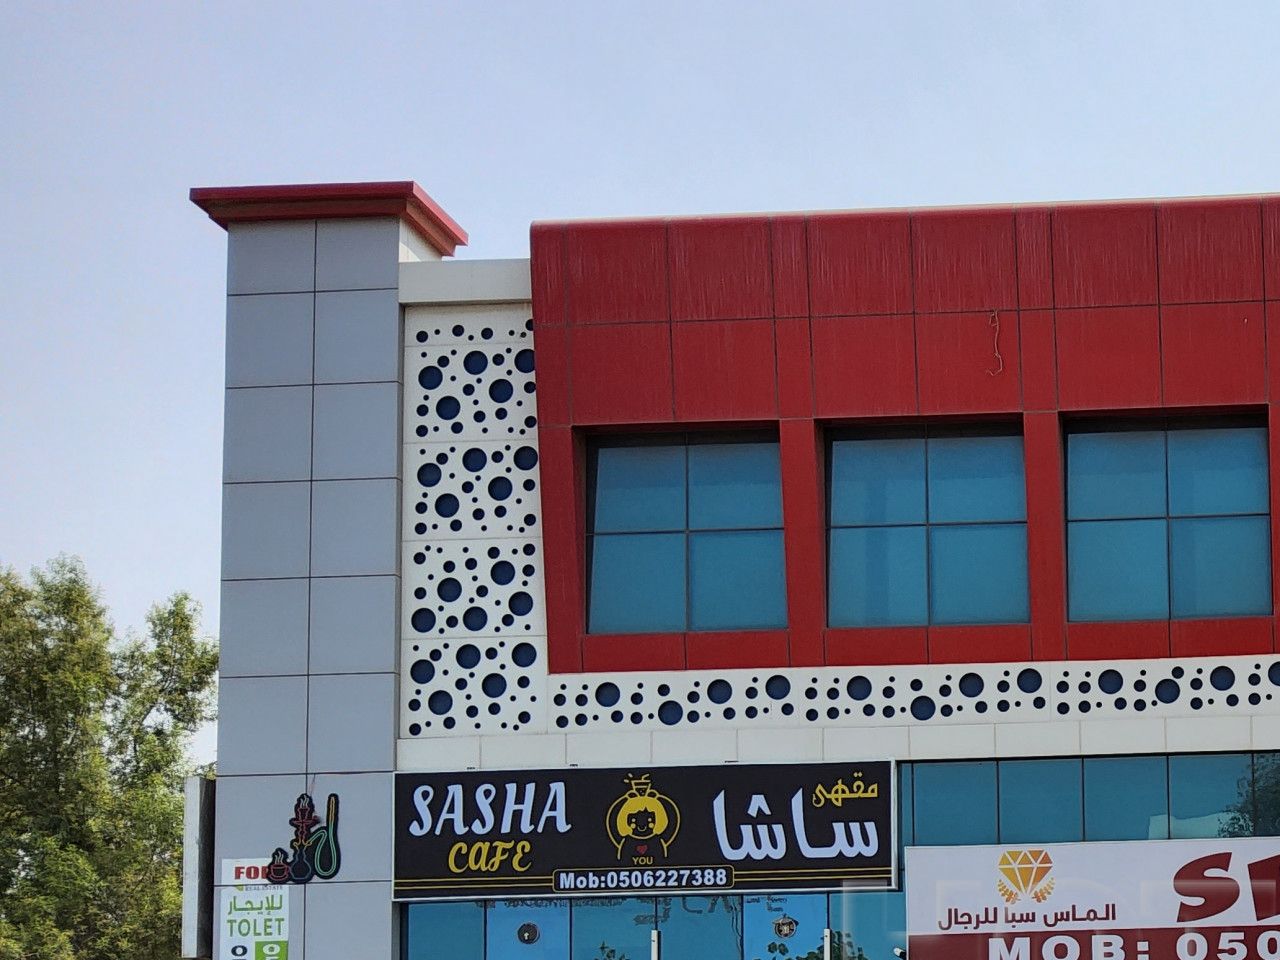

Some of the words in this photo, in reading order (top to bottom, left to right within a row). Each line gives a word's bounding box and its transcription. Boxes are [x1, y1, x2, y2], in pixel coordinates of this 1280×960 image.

[409, 781, 572, 837] SASHA
[713, 787, 879, 861] ساشا
[632, 856, 654, 865] YOU
[559, 868, 727, 889] Mob:0506227388
[226, 917, 285, 937] TOLET
[938, 907, 998, 931] للرجال
[1043, 903, 1116, 928] الماس
